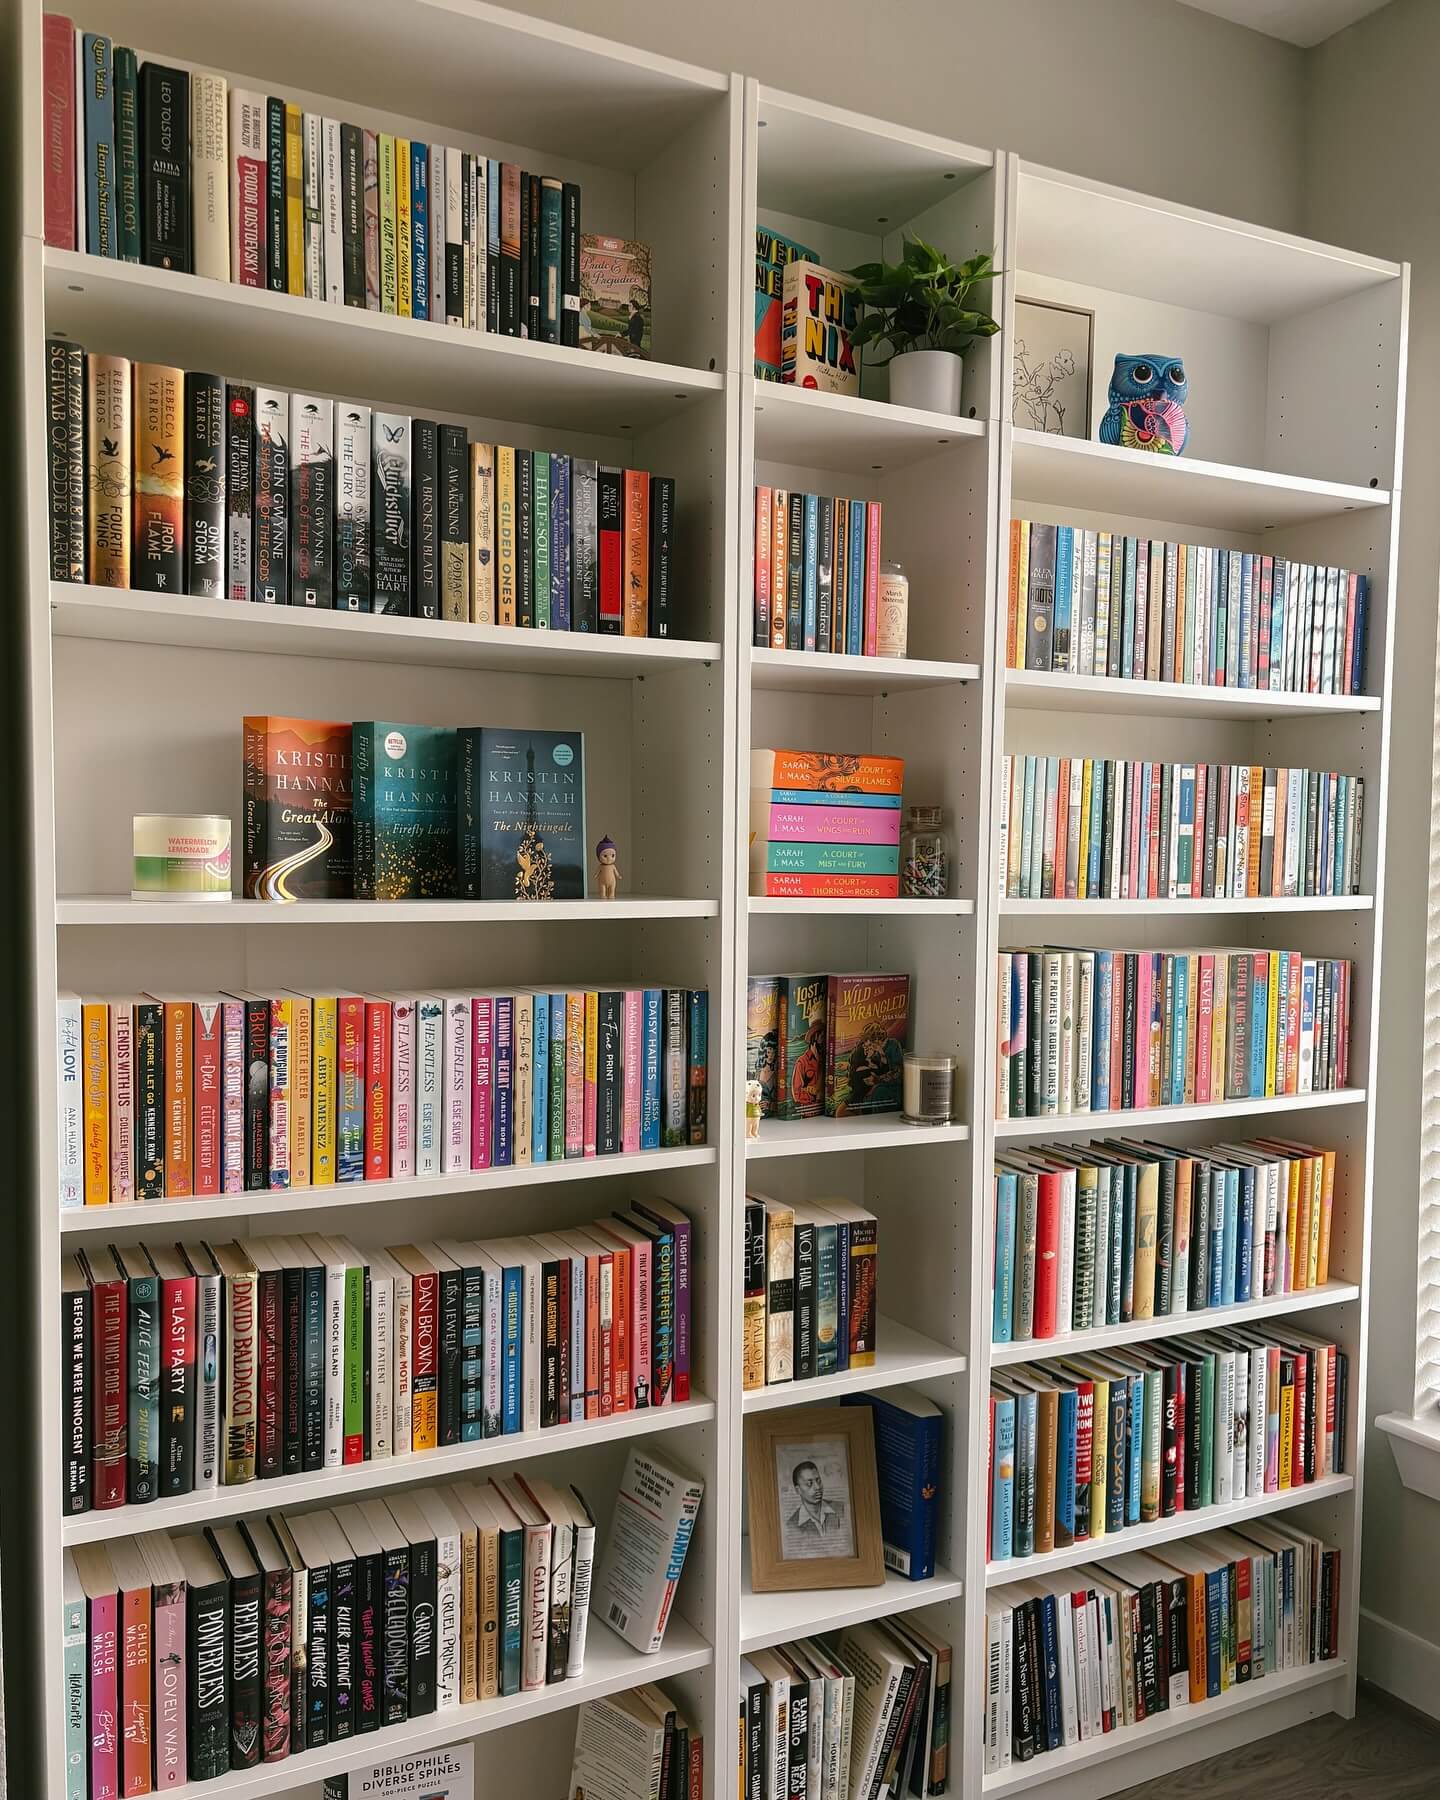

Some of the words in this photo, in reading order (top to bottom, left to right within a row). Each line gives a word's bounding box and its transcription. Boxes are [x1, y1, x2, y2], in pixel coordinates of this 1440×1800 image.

[93, 39, 106, 65] Quo
[96, 68, 107, 99] Vadis
[122, 90, 135, 116] THE
[161, 82, 171, 104] LEO
[123, 120, 135, 168] LITTLE
[161, 107, 171, 152] TOLSTOY
[271, 112, 281, 146] BLUE
[244, 163, 257, 203] FYODOR
[271, 148, 281, 199] CASTLE
[123, 173, 136, 235] TRILOGY
[244, 207, 258, 274] DOSTOEVSKY
[415, 222, 425, 249] KURT
[416, 253, 425, 306] VONNEGUT
[52, 347, 65, 420] SCHWAB
[69, 384, 82, 419] THE
[149, 382, 158, 431] YARROS
[165, 379, 174, 439] REBECCA
[196, 391, 205, 439] YARROS
[212, 388, 220, 446] REBECCA
[53, 426, 66, 449] OF
[53, 453, 67, 512] ADDIE
[70, 423, 83, 516] INVISIBLE
[315, 468, 324, 501] JOHN
[423, 473, 432, 482] A
[377, 451, 408, 548] Quicksilver
[423, 487, 432, 542] BROKEN
[449, 465, 458, 535] AWAKENING
[54, 519, 67, 578] LARUE
[71, 519, 83, 561] LIFE
[97, 513, 109, 548] WING
[111, 505, 122, 557] FOURTH
[148, 512, 161, 560] FLAME
[162, 522, 173, 553] IRON
[195, 521, 206, 564] STORM
[208, 527, 219, 561] ONYX
[313, 507, 324, 567] GWYNNE
[502, 502, 511, 558] GILDED
[376, 573, 408, 583] CALLIE
[377, 581, 408, 591] HART
[424, 546, 433, 587] BLADE
[503, 563, 511, 605] ONES
[820, 592, 829, 635] Kindred
[356, 735, 369, 773] Firefly
[359, 775, 369, 802] Lane
[489, 771, 575, 784] KRISTIN
[489, 791, 575, 804] HANNAH
[168, 838, 217, 846] WATERMELON
[493, 821, 511, 832] The
[514, 821, 573, 834] Nightingale
[168, 846, 210, 854] LEMONADE
[1050, 980, 1058, 1024] PROPHETS
[1202, 969, 1211, 1015] NEVER
[118, 1017, 129, 1026] IT
[478, 1003, 489, 1043] HOLDING
[649, 1000, 657, 1036] DAISY
[118, 1030, 129, 1058] ENDS
[228, 1031, 240, 1062] FUNNY
[398, 1023, 409, 1092] FLAWLESS
[424, 1022, 435, 1092] HEARTLESS
[454, 1018, 464, 1091] POWERLESS
[648, 1039, 656, 1080] HAITES
[1049, 1032, 1057, 1065] ROBERT
[64, 1049, 75, 1081] LOVE
[118, 1060, 129, 1089] WITH
[228, 1065, 240, 1096] STORY
[318, 1055, 326, 1088] ABBY
[478, 1058, 488, 1085] REINS
[68, 1108, 76, 1127] ANA
[119, 1093, 129, 1106] US
[373, 1086, 383, 1119] YOURS
[120, 1117, 128, 1148] COLLEEN
[228, 1110, 241, 1136] EMILY
[318, 1091, 326, 1149] JIMENEZ
[373, 1122, 383, 1151] TRULY
[69, 1131, 77, 1164] HUANG
[228, 1141, 240, 1170] HENRY
[799, 1229, 812, 1262] WOLF
[418, 1278, 433, 1311] DAN
[661, 1245, 670, 1327] COUNTERFEIT
[679, 1269, 687, 1289] RISK
[799, 1267, 812, 1290] HALL
[74, 1297, 82, 1340] BEFORE
[171, 1307, 185, 1342] LAST
[233, 1282, 252, 1332] DAVID
[508, 1292, 517, 1339] HOUSEMAID
[138, 1308, 151, 1348] ALICE
[418, 1315, 433, 1374] BROWN
[74, 1343, 82, 1360] WE
[171, 1349, 185, 1393] PARTY
[74, 1363, 82, 1393] WERE
[137, 1352, 149, 1400] FEENEY
[233, 1336, 252, 1418] BALDACCI
[74, 1396, 82, 1455] INNOCENT
[1114, 1405, 1125, 1496] DUCKS
[665, 1518, 694, 1581] STAMPED
[442, 1594, 455, 1634] CRUEL
[506, 1579, 520, 1627] SHATTER
[532, 1566, 546, 1641] GALLANT
[126, 1625, 136, 1667] WALSH
[138, 1624, 147, 1665] CHLOE
[234, 1600, 258, 1680] RECKLESS
[412, 1603, 434, 1660] CARAVAL
[1018, 1642, 1026, 1661] The
[197, 1608, 224, 1708] POWERLESS
[440, 1638, 456, 1682] PRINCE
[1019, 1664, 1028, 1686] New
[1144, 1634, 1154, 1686] SWERVE
[164, 1667, 177, 1722] LOVELY
[1020, 1688, 1029, 1704] Jim
[792, 1700, 800, 1746] CASTILLO
[1022, 1706, 1030, 1733] Crow
[165, 1728, 177, 1766] WAR
[372, 1753, 451, 1778] BIBLIOPHILE
[829, 1743, 837, 1788] HOMESICK
[362, 1773, 416, 1792] DIVERSE
[418, 1763, 461, 1784] SPINES
